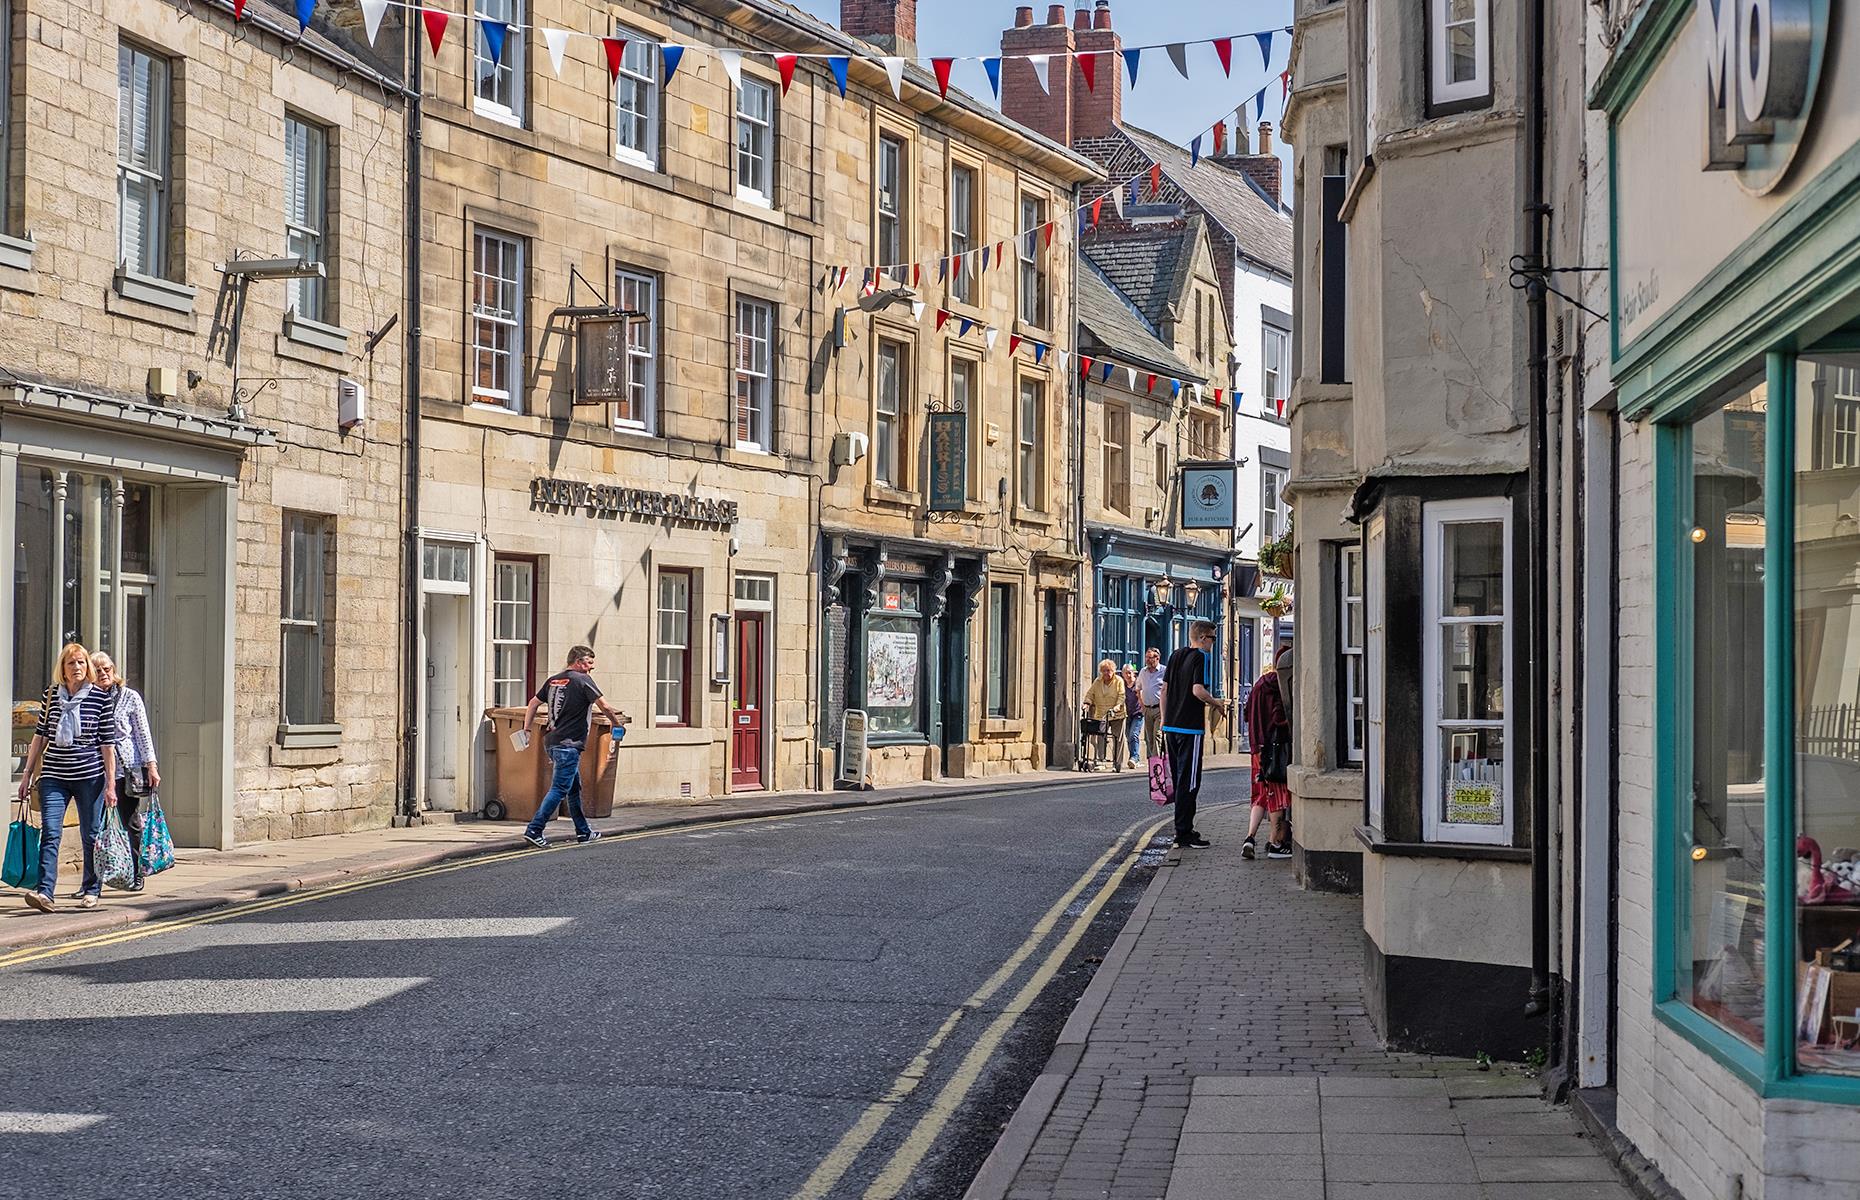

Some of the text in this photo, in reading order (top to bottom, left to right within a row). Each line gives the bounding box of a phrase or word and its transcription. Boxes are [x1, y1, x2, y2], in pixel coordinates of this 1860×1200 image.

[1623, 267, 1660, 329] Hair Studio
[934, 421, 952, 494] HARRISS
[529, 476, 740, 525] NEW SILVER PALACE
[1455, 795, 1491, 803] TEEZER
